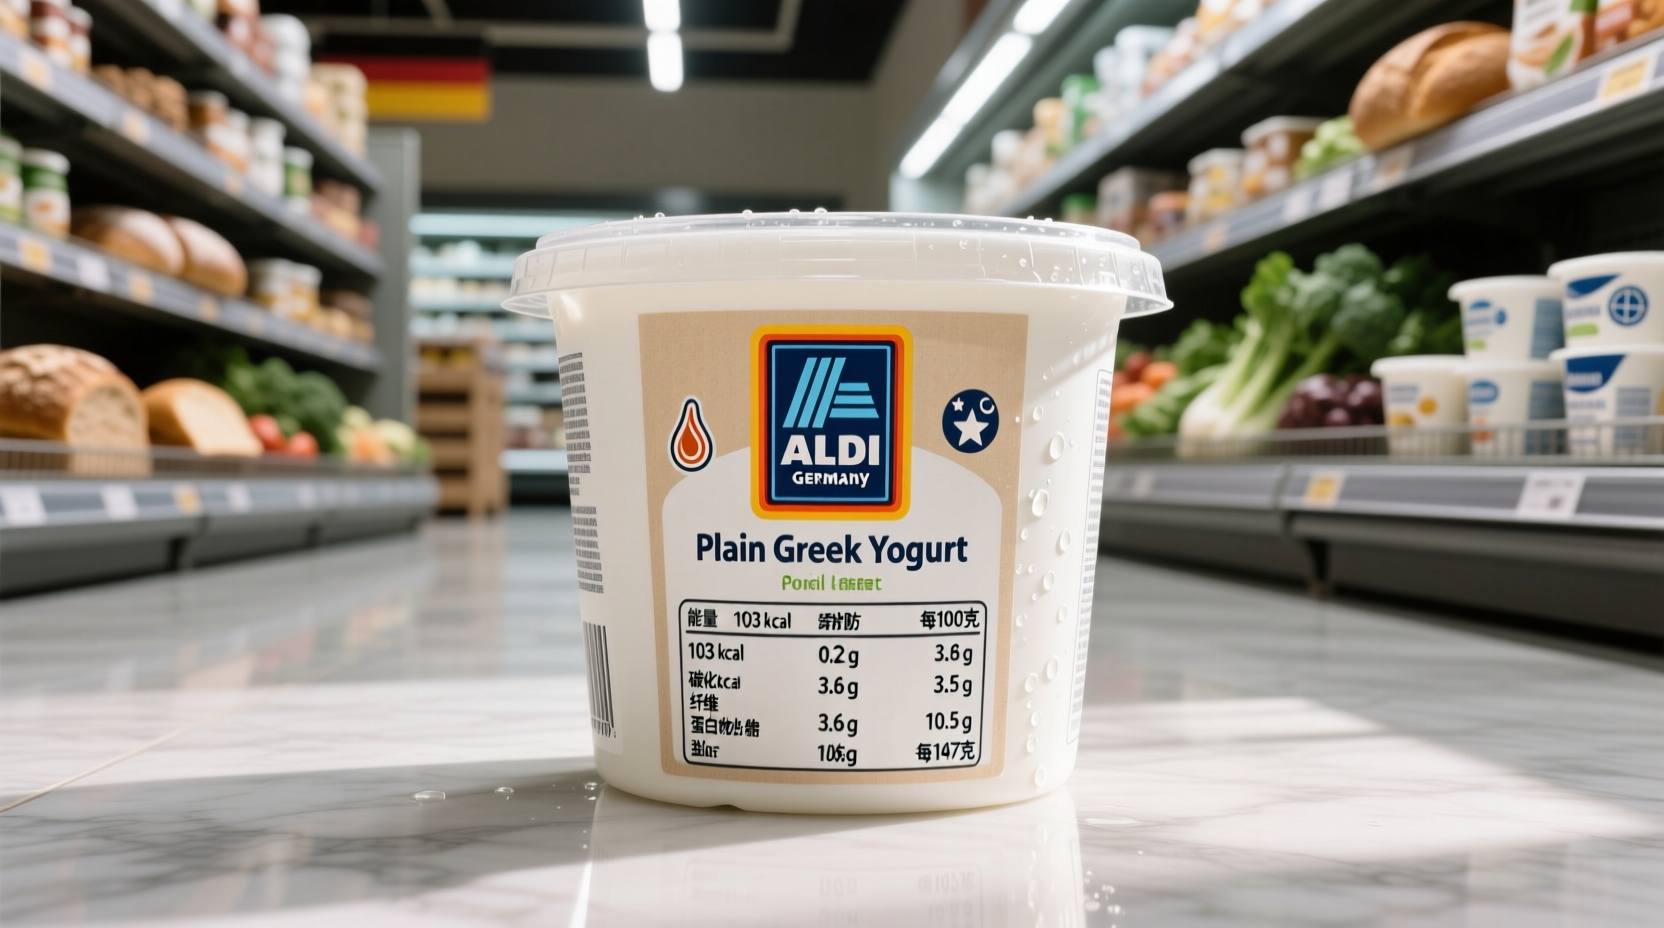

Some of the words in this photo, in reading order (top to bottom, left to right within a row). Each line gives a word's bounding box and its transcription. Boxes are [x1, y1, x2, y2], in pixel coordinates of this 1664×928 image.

[780, 435, 880, 465] ALDI
[697, 532, 766, 562] Plain
[773, 534, 863, 563] Greek
[868, 534, 969, 571] Yogurt
[687, 607, 718, 628] 能量
[733, 611, 761, 629] 103
[764, 611, 792, 630] kcal
[919, 607, 980, 631] 每100克
[687, 642, 715, 661] 103
[717, 643, 745, 662] kcal
[818, 645, 846, 665] 0.2
[848, 649, 859, 669] g
[934, 643, 960, 663] 3.6
[962, 648, 973, 667] g
[818, 676, 845, 695] 3.6
[847, 681, 859, 700] g
[933, 674, 960, 694] 3.5
[962, 679, 973, 697] g
[818, 712, 845, 733] 3.6
[847, 718, 859, 737] g
[925, 711, 960, 731] 10.5
[962, 716, 973, 734] g
